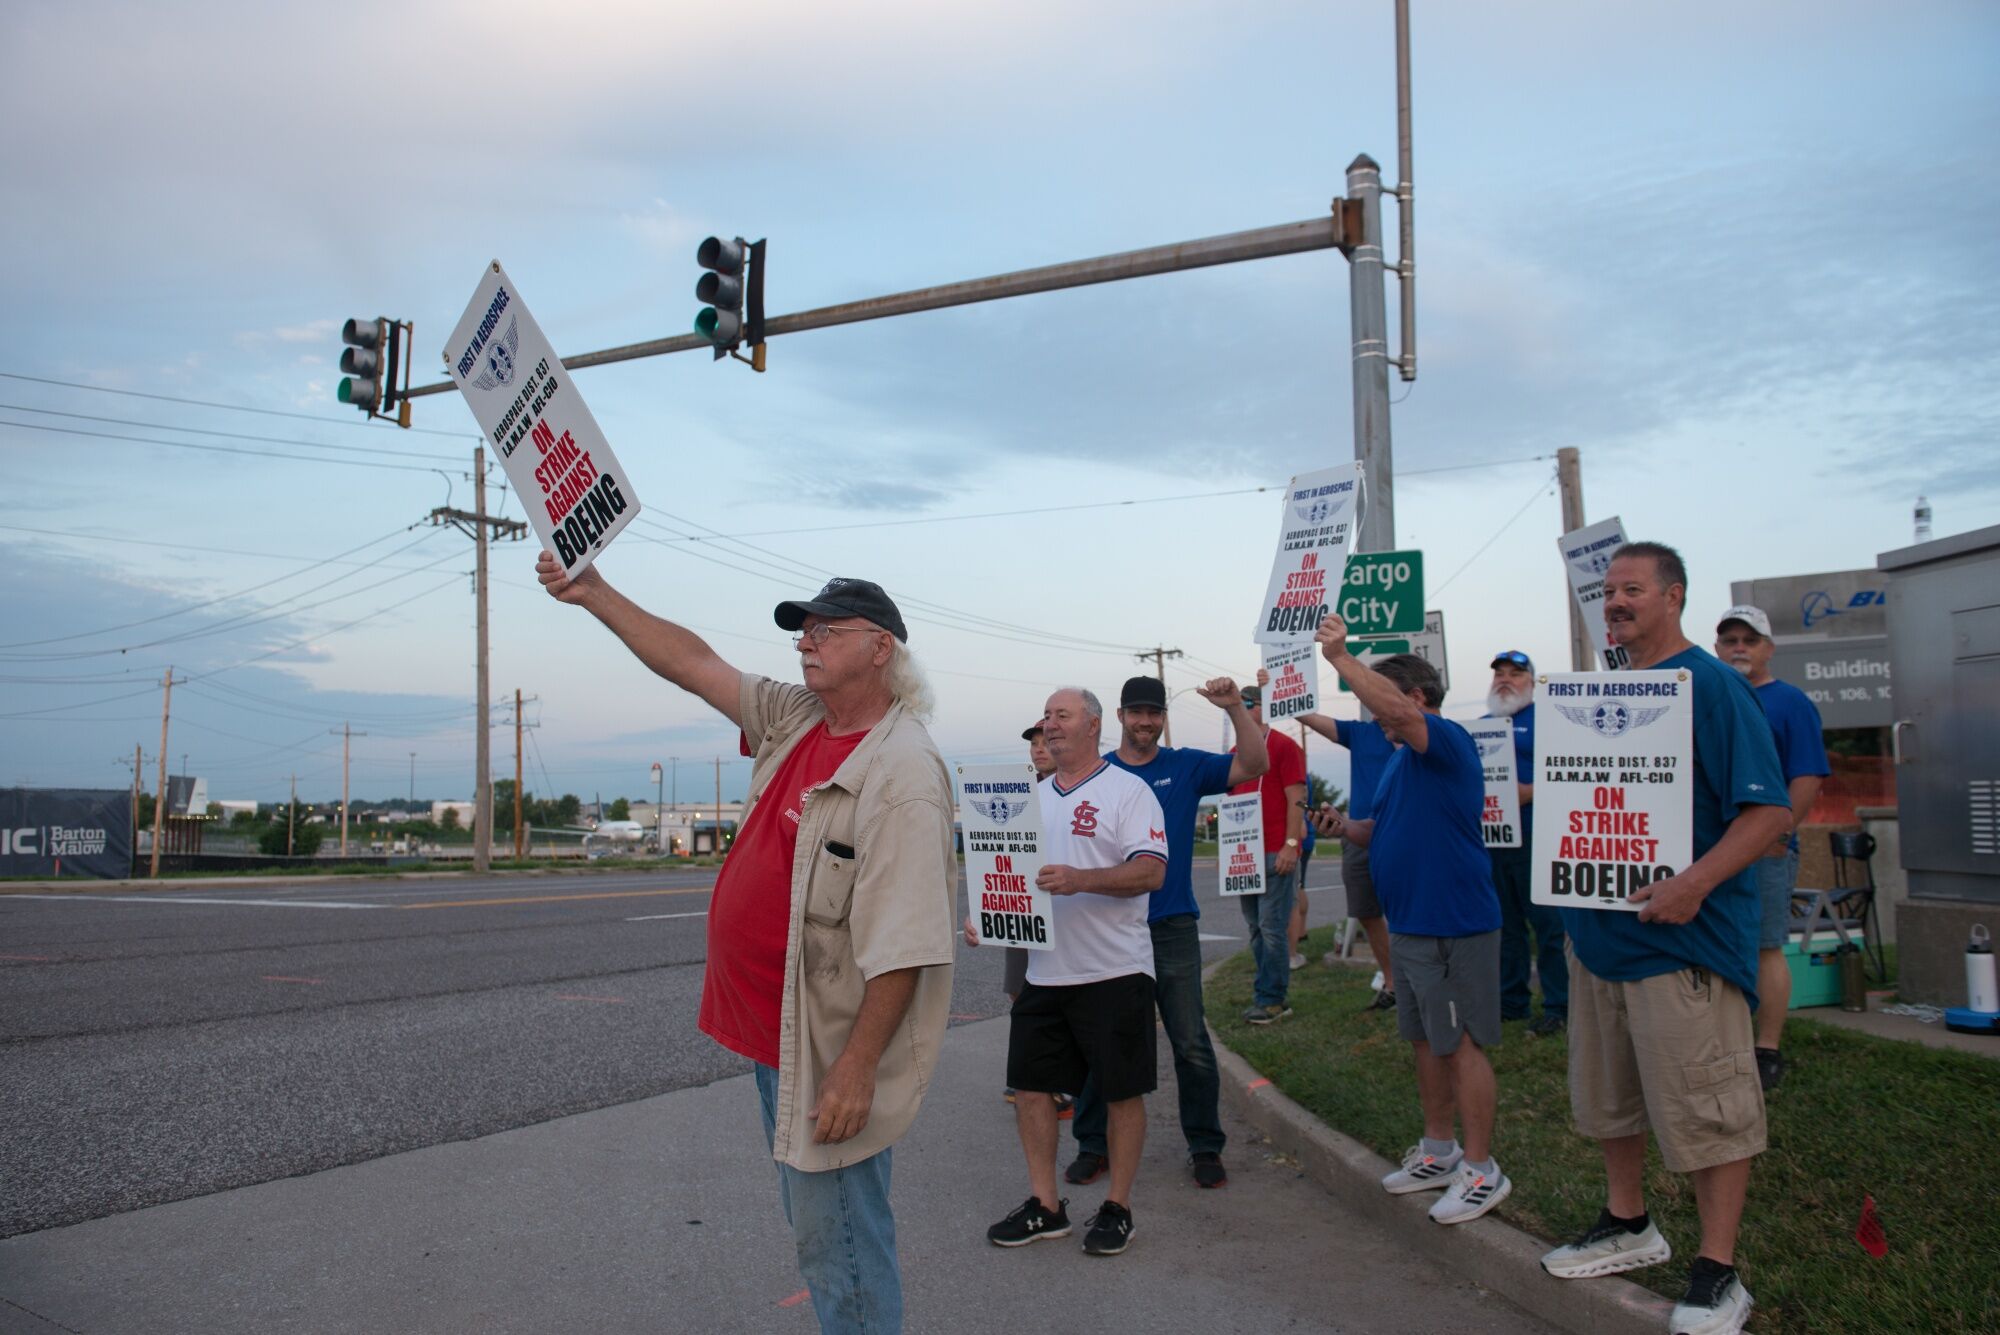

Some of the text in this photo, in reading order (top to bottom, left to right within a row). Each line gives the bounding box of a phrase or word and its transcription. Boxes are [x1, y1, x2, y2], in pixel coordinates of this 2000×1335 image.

[457, 286, 510, 379] FIRST IN AEROSPACE
[493, 358, 550, 444] AEROSPACE DIST. 837
[502, 376, 558, 458] I.A.M.A.W AFL-CIO
[531, 418, 556, 455] ON
[534, 429, 581, 494] STRIKE
[544, 451, 599, 526] AGAINST
[1293, 480, 1354, 501] FIRST IN AEROSPACE
[551, 473, 628, 569] BOEING
[1286, 527, 1318, 541] AEROSPACE
[1301, 552, 1318, 571] ON
[1286, 569, 1326, 590] STRIKE
[1276, 588, 1326, 609] AGAINST
[1342, 597, 1399, 629] City
[1283, 663, 1295, 676] ON
[1275, 672, 1304, 689] STRIKE
[1548, 682, 1678, 697] FIRST IN AEROSPACE
[1272, 683, 1307, 701] AGAINST
[1270, 693, 1314, 718] BOEING
[1545, 756, 1678, 768] AEROSPACE DIST. 837
[1547, 771, 1674, 784] I.A.M.A.W AFL-CIO
[964, 782, 1031, 794] FIRST IN AEROSPACE
[1594, 786, 1625, 810] ON
[50, 825, 106, 841] Barton
[1569, 810, 1650, 836] STRIKE
[969, 831, 1037, 841] AEROSPACE DIST. 837
[50, 840, 106, 856] Malow
[971, 843, 1037, 853] I.A.M.A.W AFL-CIO
[1558, 835, 1659, 863] AGAINST
[995, 854, 1012, 873] ON
[1230, 853, 1254, 865] STRIKE
[1228, 864, 1257, 876] AGAINST
[983, 873, 1027, 893] STRIKE
[1225, 873, 1261, 892] BOEING
[981, 892, 1033, 914] AGAINST
[980, 911, 1047, 943] BOEING
